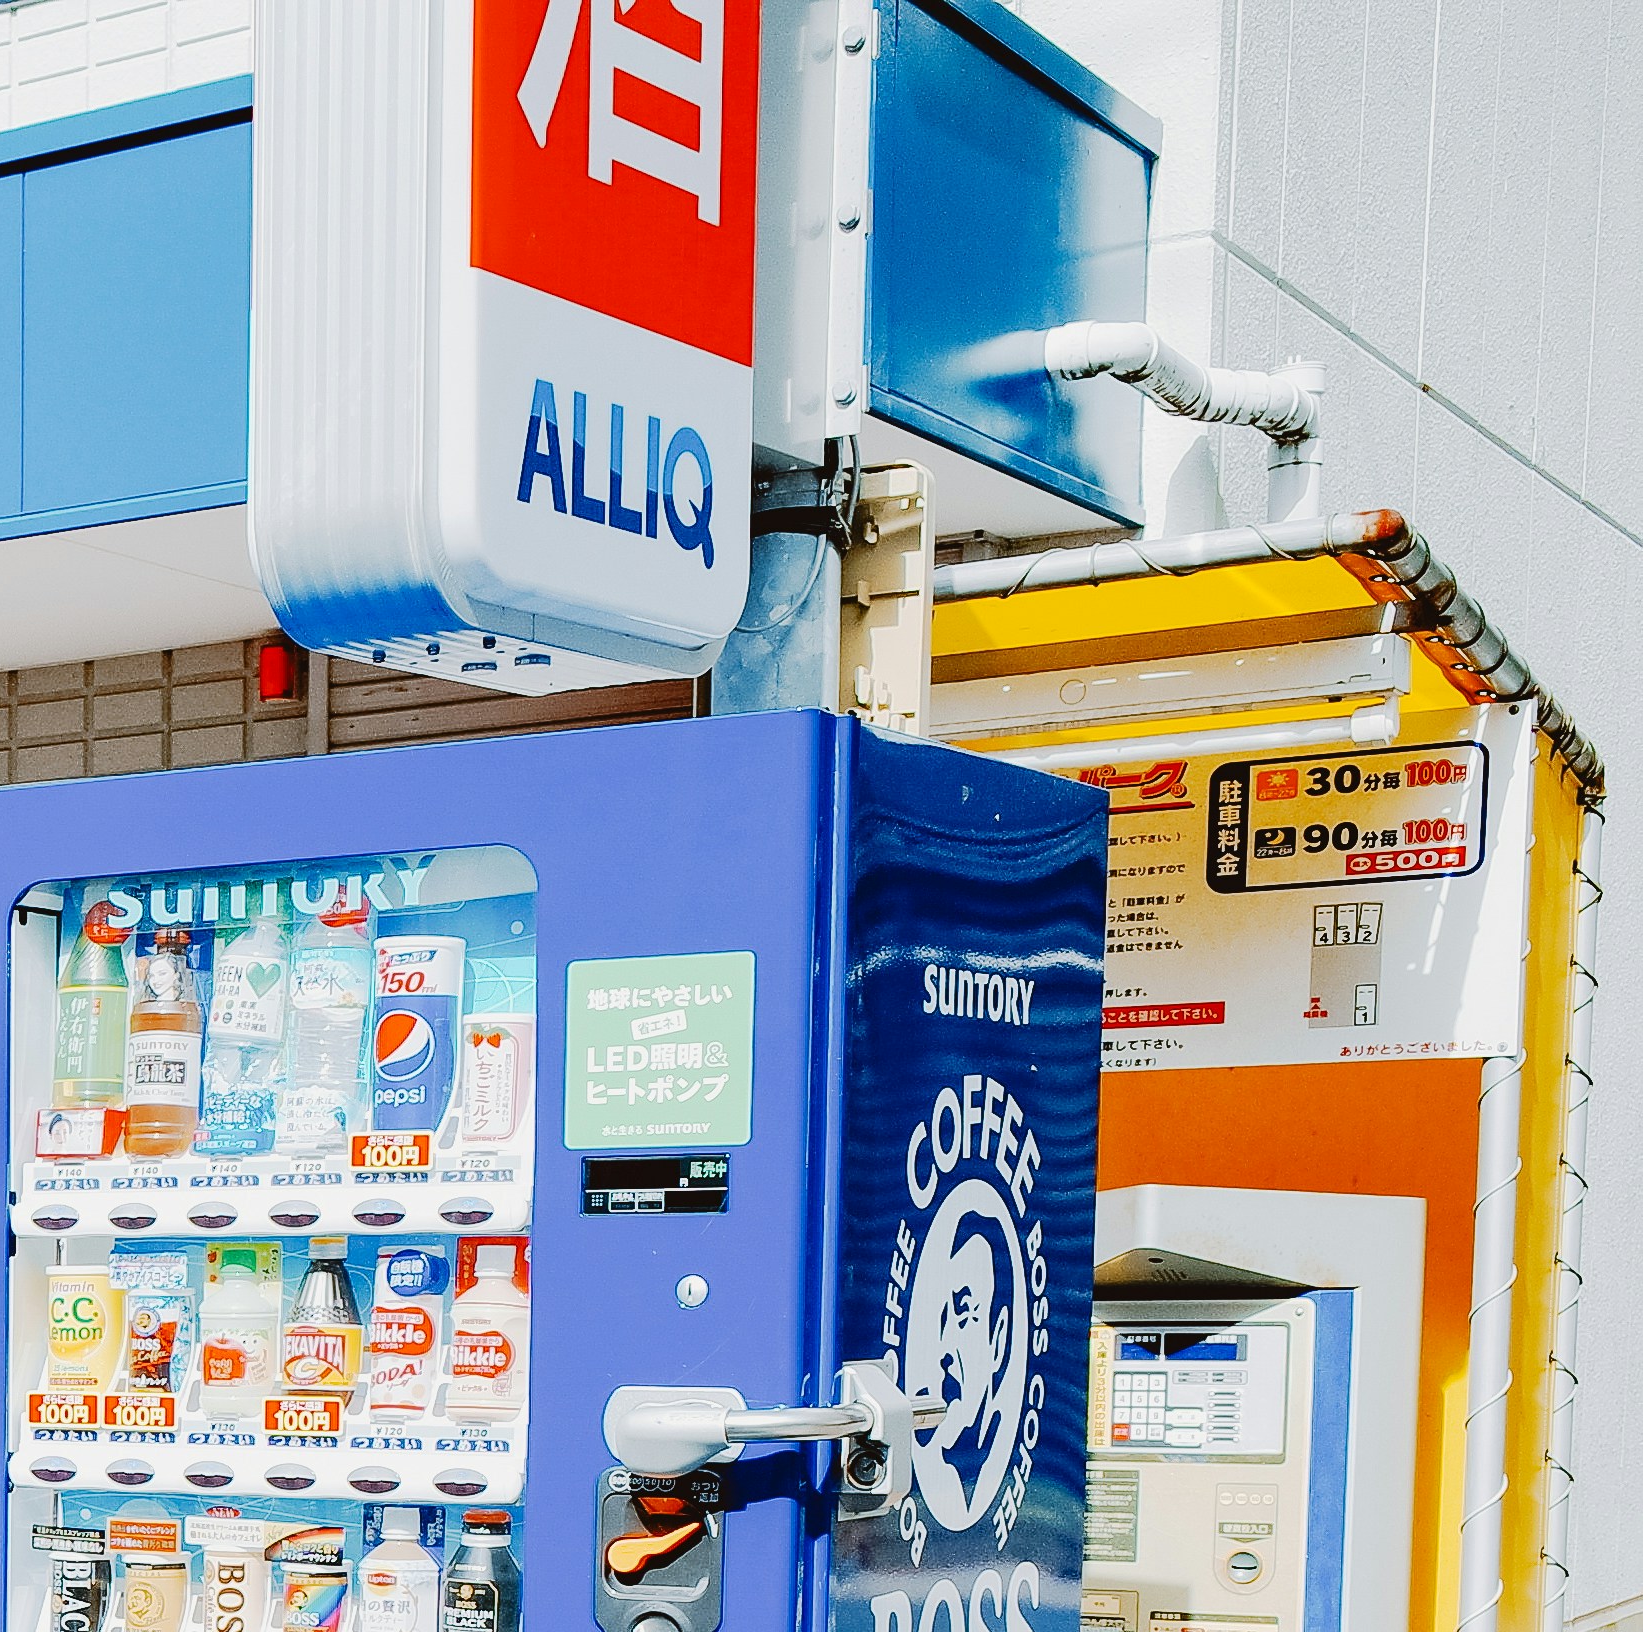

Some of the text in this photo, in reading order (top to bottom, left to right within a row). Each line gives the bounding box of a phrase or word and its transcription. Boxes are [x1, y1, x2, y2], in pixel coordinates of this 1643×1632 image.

[517, 379, 715, 569] ALLIQ
[1304, 759, 1469, 797] 30分毎 100円
[1217, 780, 1242, 876] 駐車料金
[1303, 819, 1467, 854] 90分毎 100円
[1375, 851, 1459, 871] 500円
[1320, 932, 1329, 943] 4
[1363, 931, 1372, 943] 2
[586, 983, 733, 1011] 地球にやさしい
[922, 962, 1035, 1026] SUNTORY
[67, 997, 88, 1074] 伊右衛門
[637, 1014, 683, 1037] 省エネ!
[136, 1042, 189, 1051] SUNTORY
[586, 1042, 729, 1073] LED照明&
[374, 1085, 426, 1108] pepsi
[474, 1048, 494, 1132] いちごミルク
[586, 1073, 729, 1106] ヒートポンプ
[646, 1121, 712, 1135] SUNTORY
[362, 1146, 419, 1166] 100円
[905, 1073, 1041, 1219] COFFEE
[38, 1404, 90, 1424] 100円
[113, 1407, 165, 1426] 100円
[274, 1410, 331, 1431] 100円
